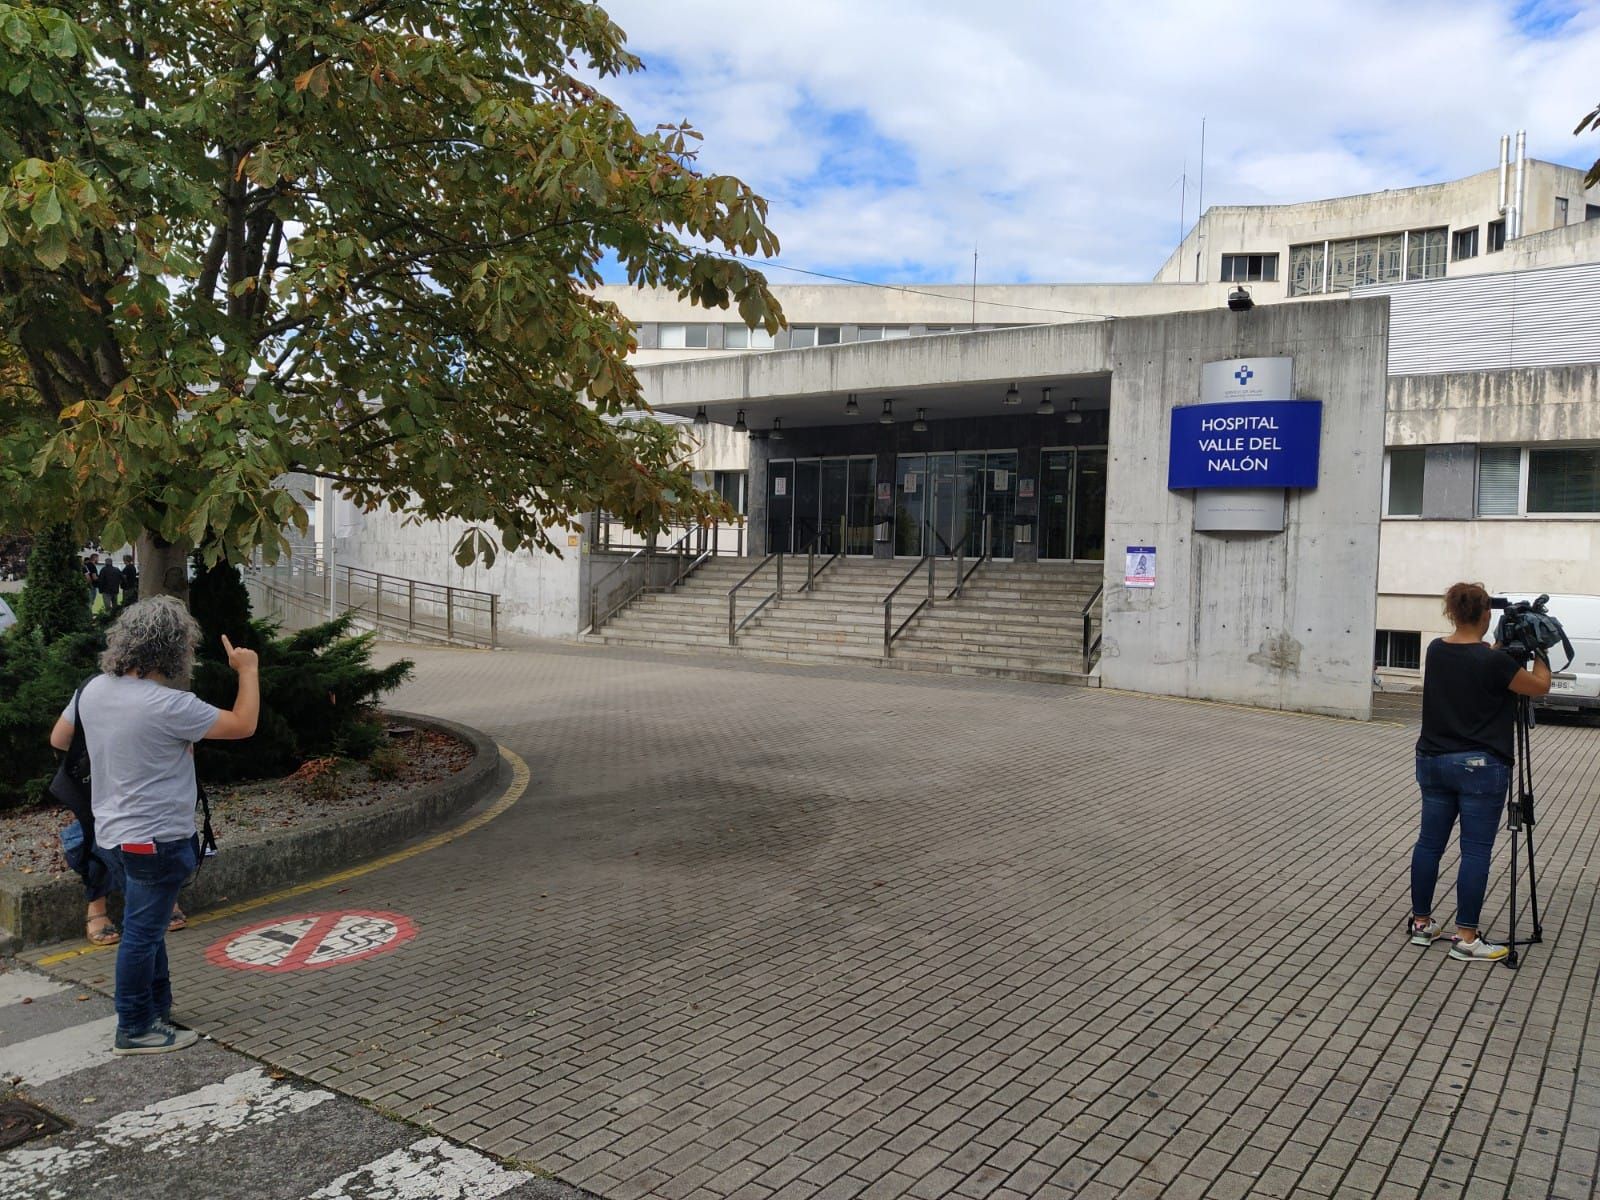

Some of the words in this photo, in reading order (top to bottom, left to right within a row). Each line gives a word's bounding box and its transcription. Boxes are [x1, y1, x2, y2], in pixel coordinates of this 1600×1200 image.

[1201, 416, 1279, 431] HOSPITAL
[1198, 438, 1244, 452] VALLE
[1249, 437, 1281, 450] DEL
[1208, 455, 1268, 471] NALÓN
